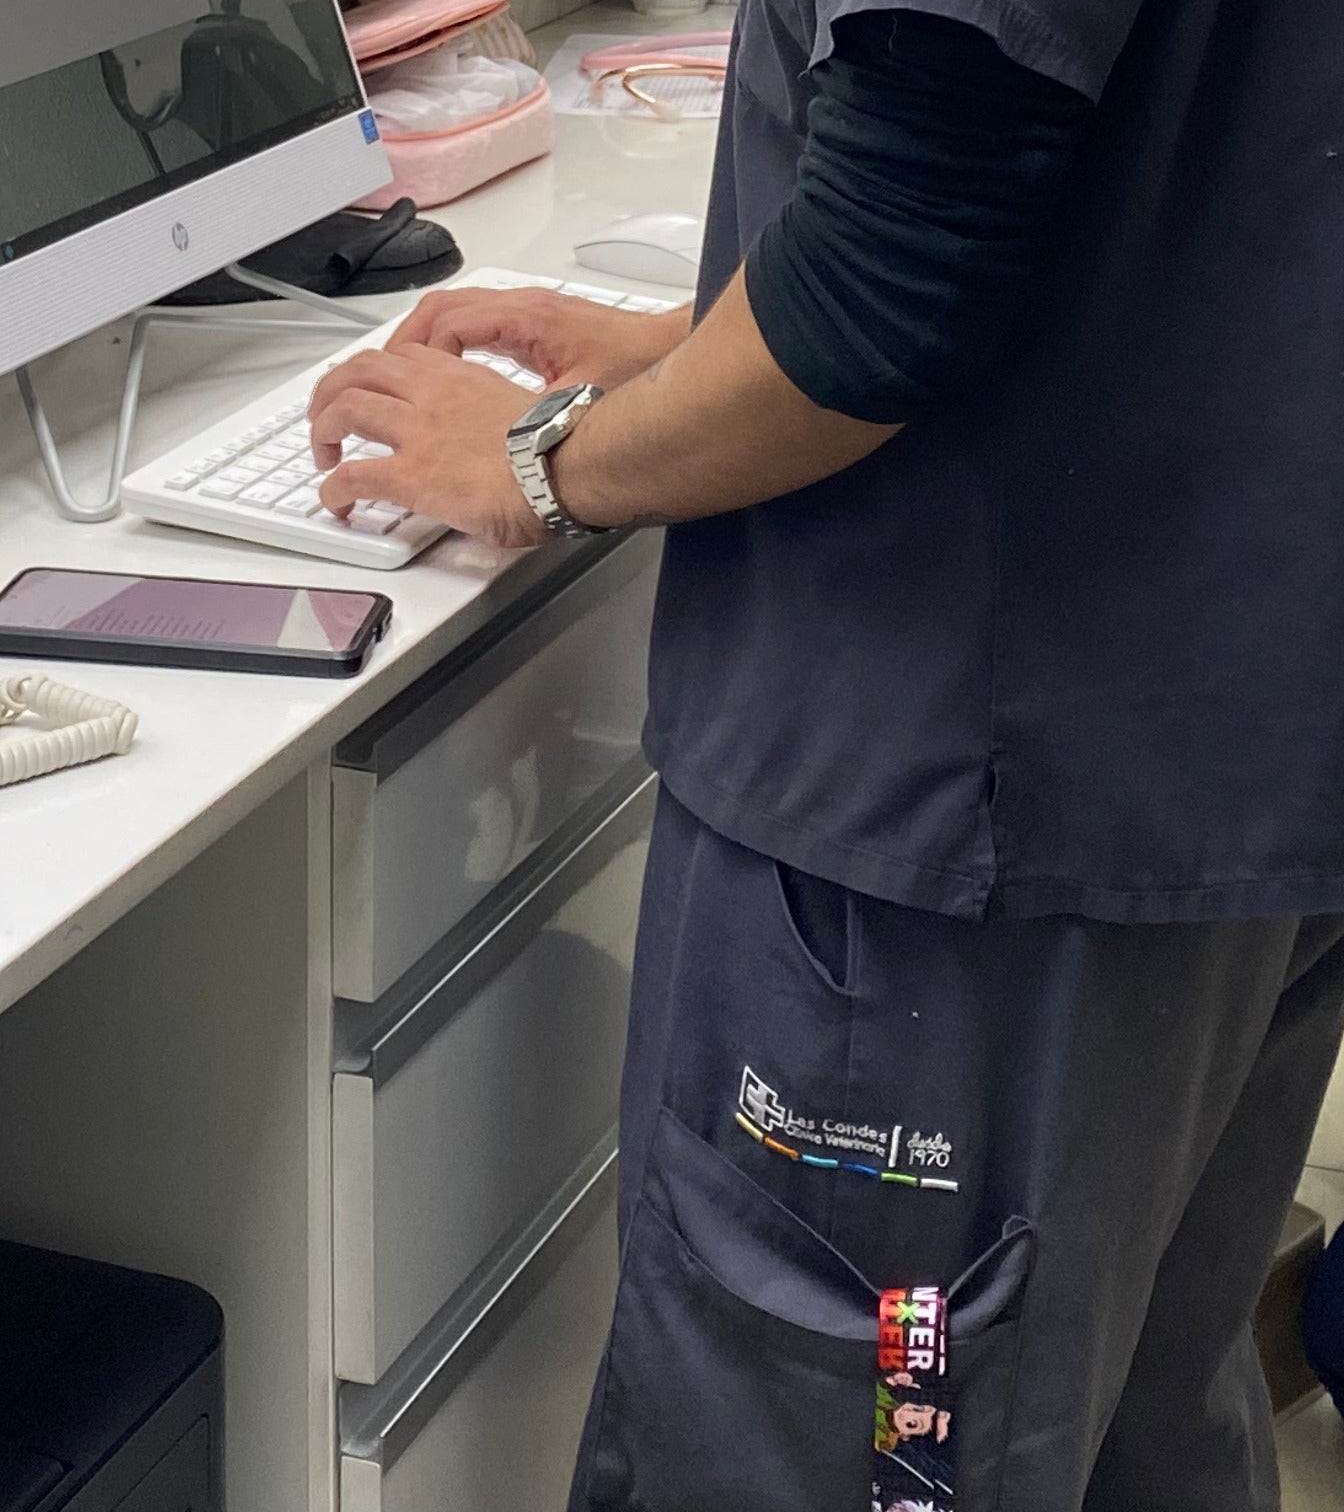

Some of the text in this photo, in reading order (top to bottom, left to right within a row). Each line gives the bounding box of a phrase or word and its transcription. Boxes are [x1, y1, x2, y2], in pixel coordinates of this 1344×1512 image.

[788, 1109, 888, 1143] Las Condes
[909, 1148, 950, 1168] 1970
